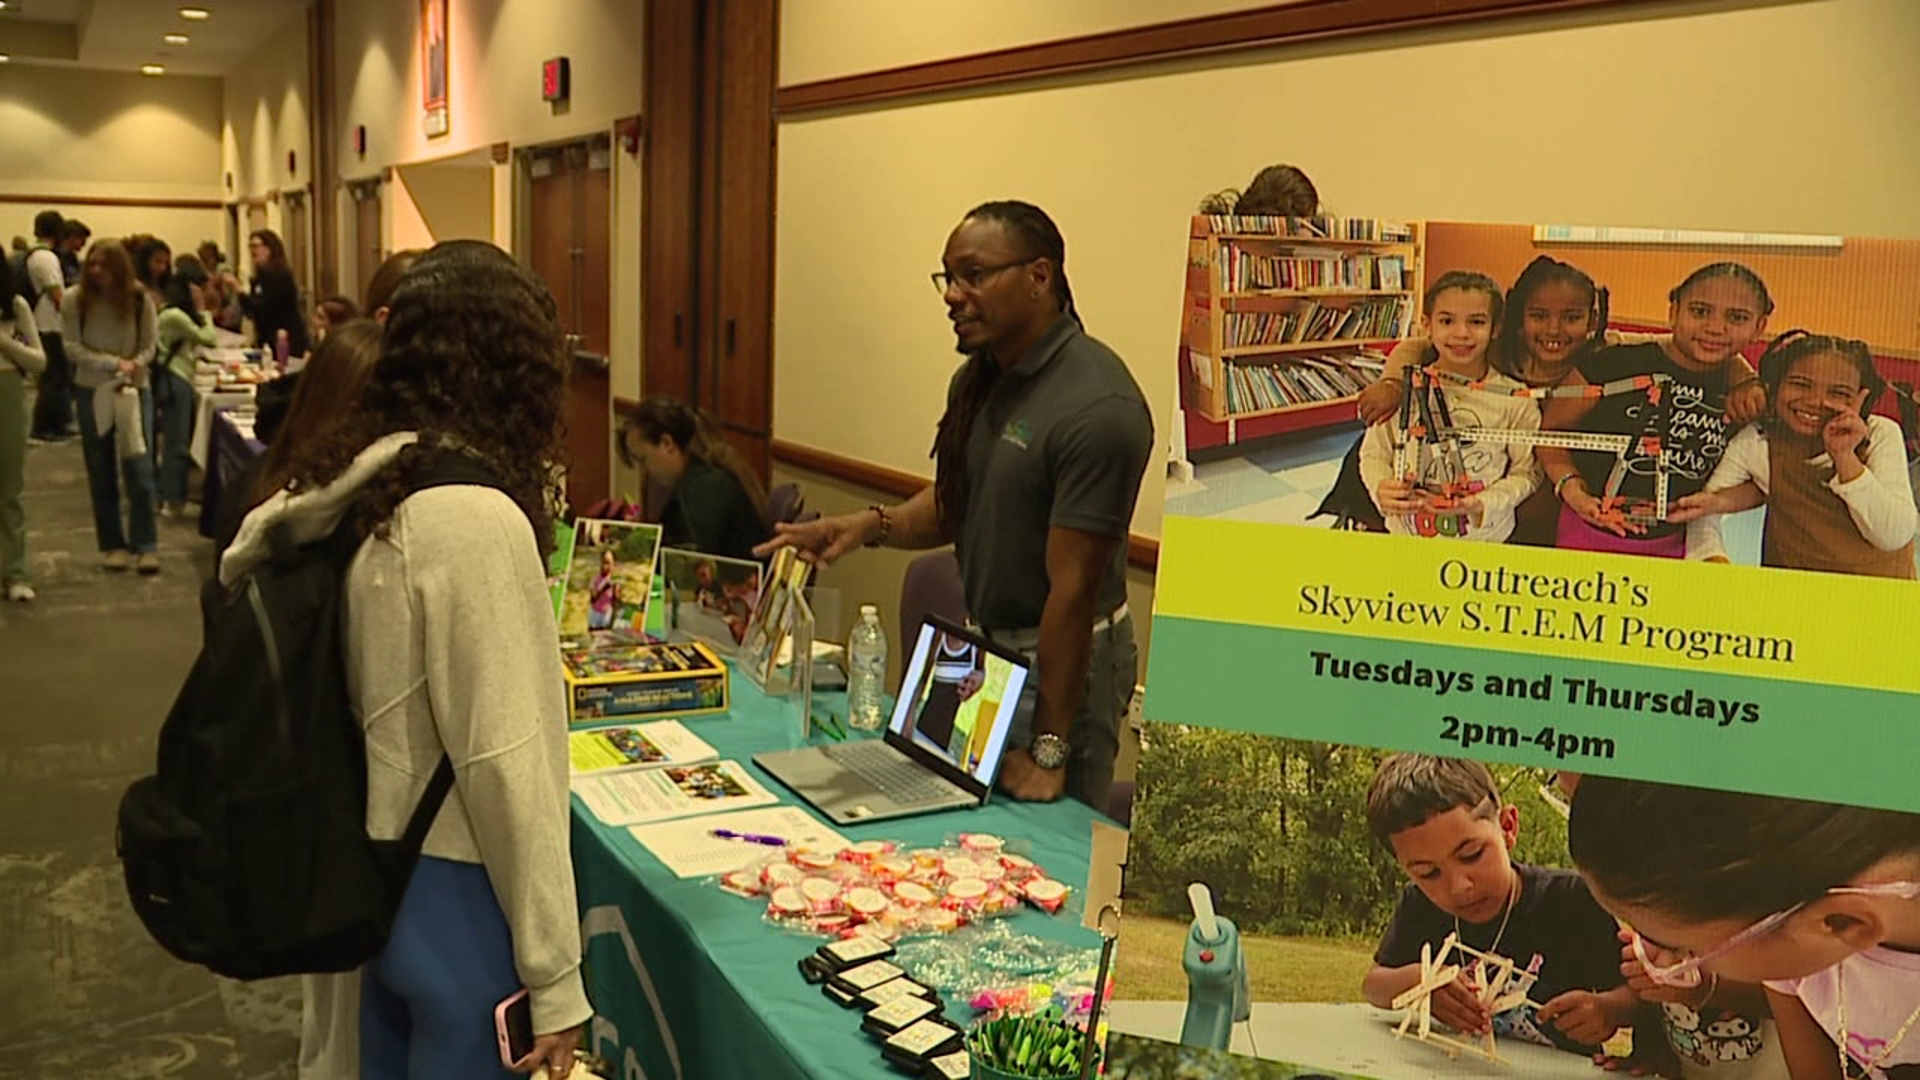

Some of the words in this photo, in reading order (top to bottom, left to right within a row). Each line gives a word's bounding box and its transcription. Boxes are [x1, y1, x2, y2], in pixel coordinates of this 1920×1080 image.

[1440, 559, 1650, 607] Outreach’s
[1298, 586, 1449, 626] Skyview
[1460, 601, 1605, 643] S.T.E.M
[1619, 616, 1794, 662] Program
[1310, 651, 1474, 696] Tuesdays
[1484, 674, 1553, 701] and
[1562, 678, 1760, 727] Thursdays
[1440, 716, 1616, 760] 2pm-4pm
